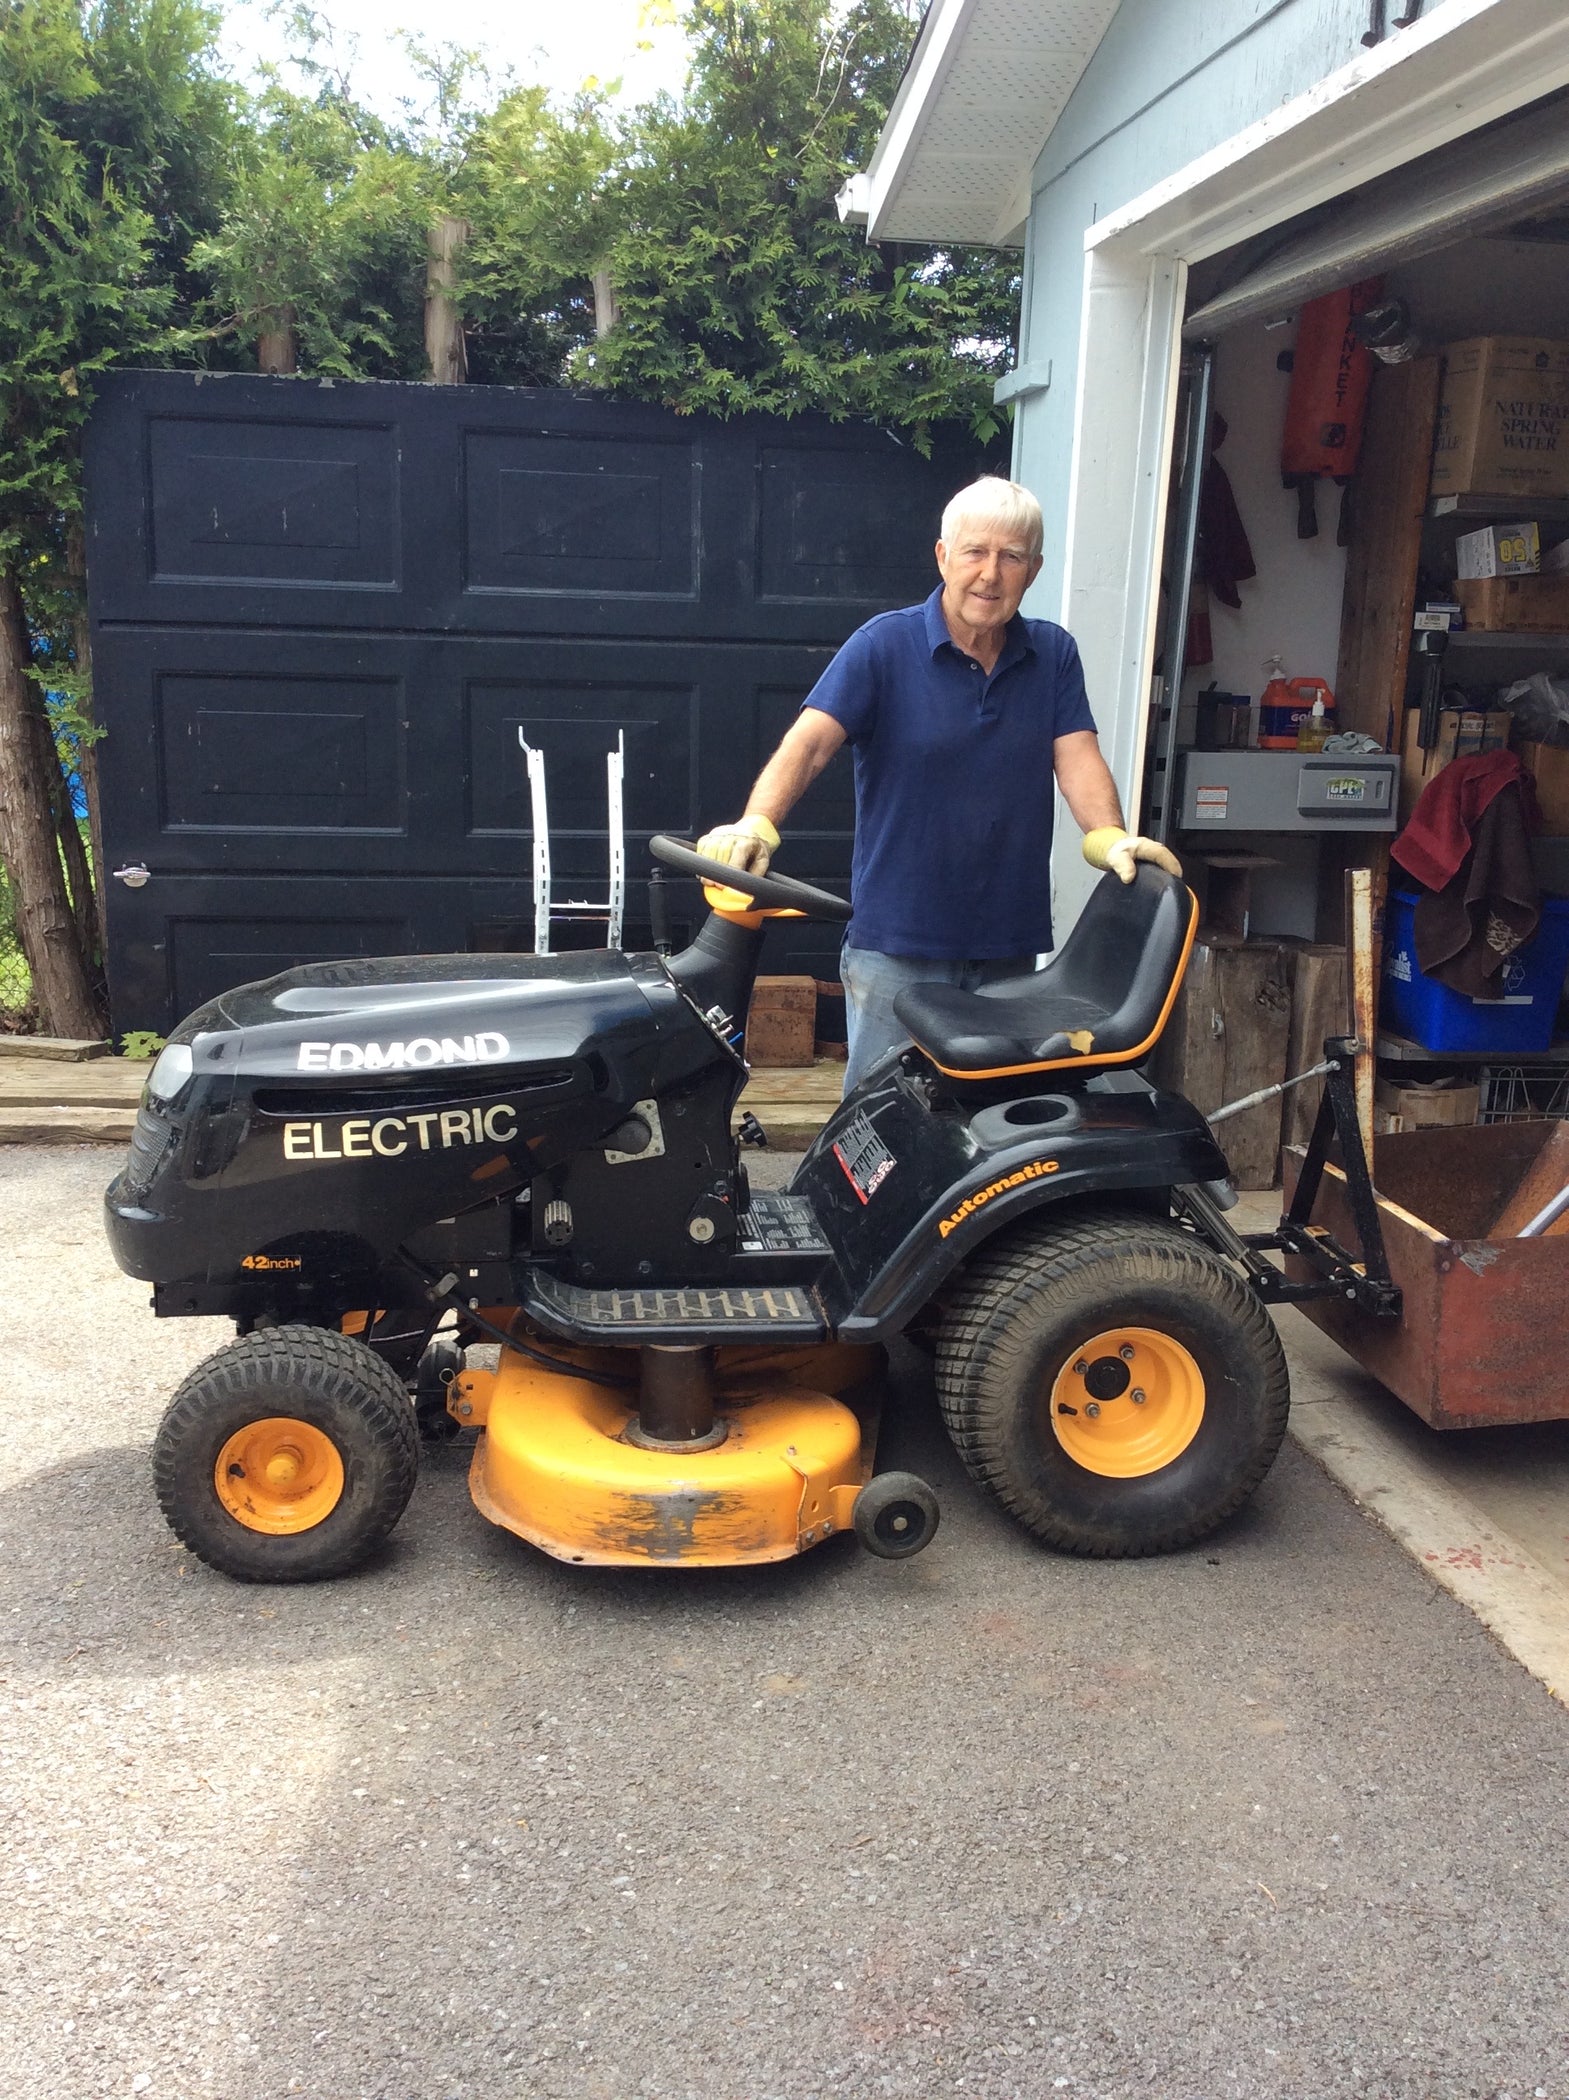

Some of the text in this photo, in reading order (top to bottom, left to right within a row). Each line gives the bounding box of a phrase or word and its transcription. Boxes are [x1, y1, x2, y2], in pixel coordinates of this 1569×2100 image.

[1501, 418, 1560, 434] SPRING
[1503, 434, 1557, 450] WATER
[297, 1032, 510, 1071] EDMOND
[283, 1104, 518, 1160] ELECTRIC
[938, 1160, 1060, 1239] Automatic
